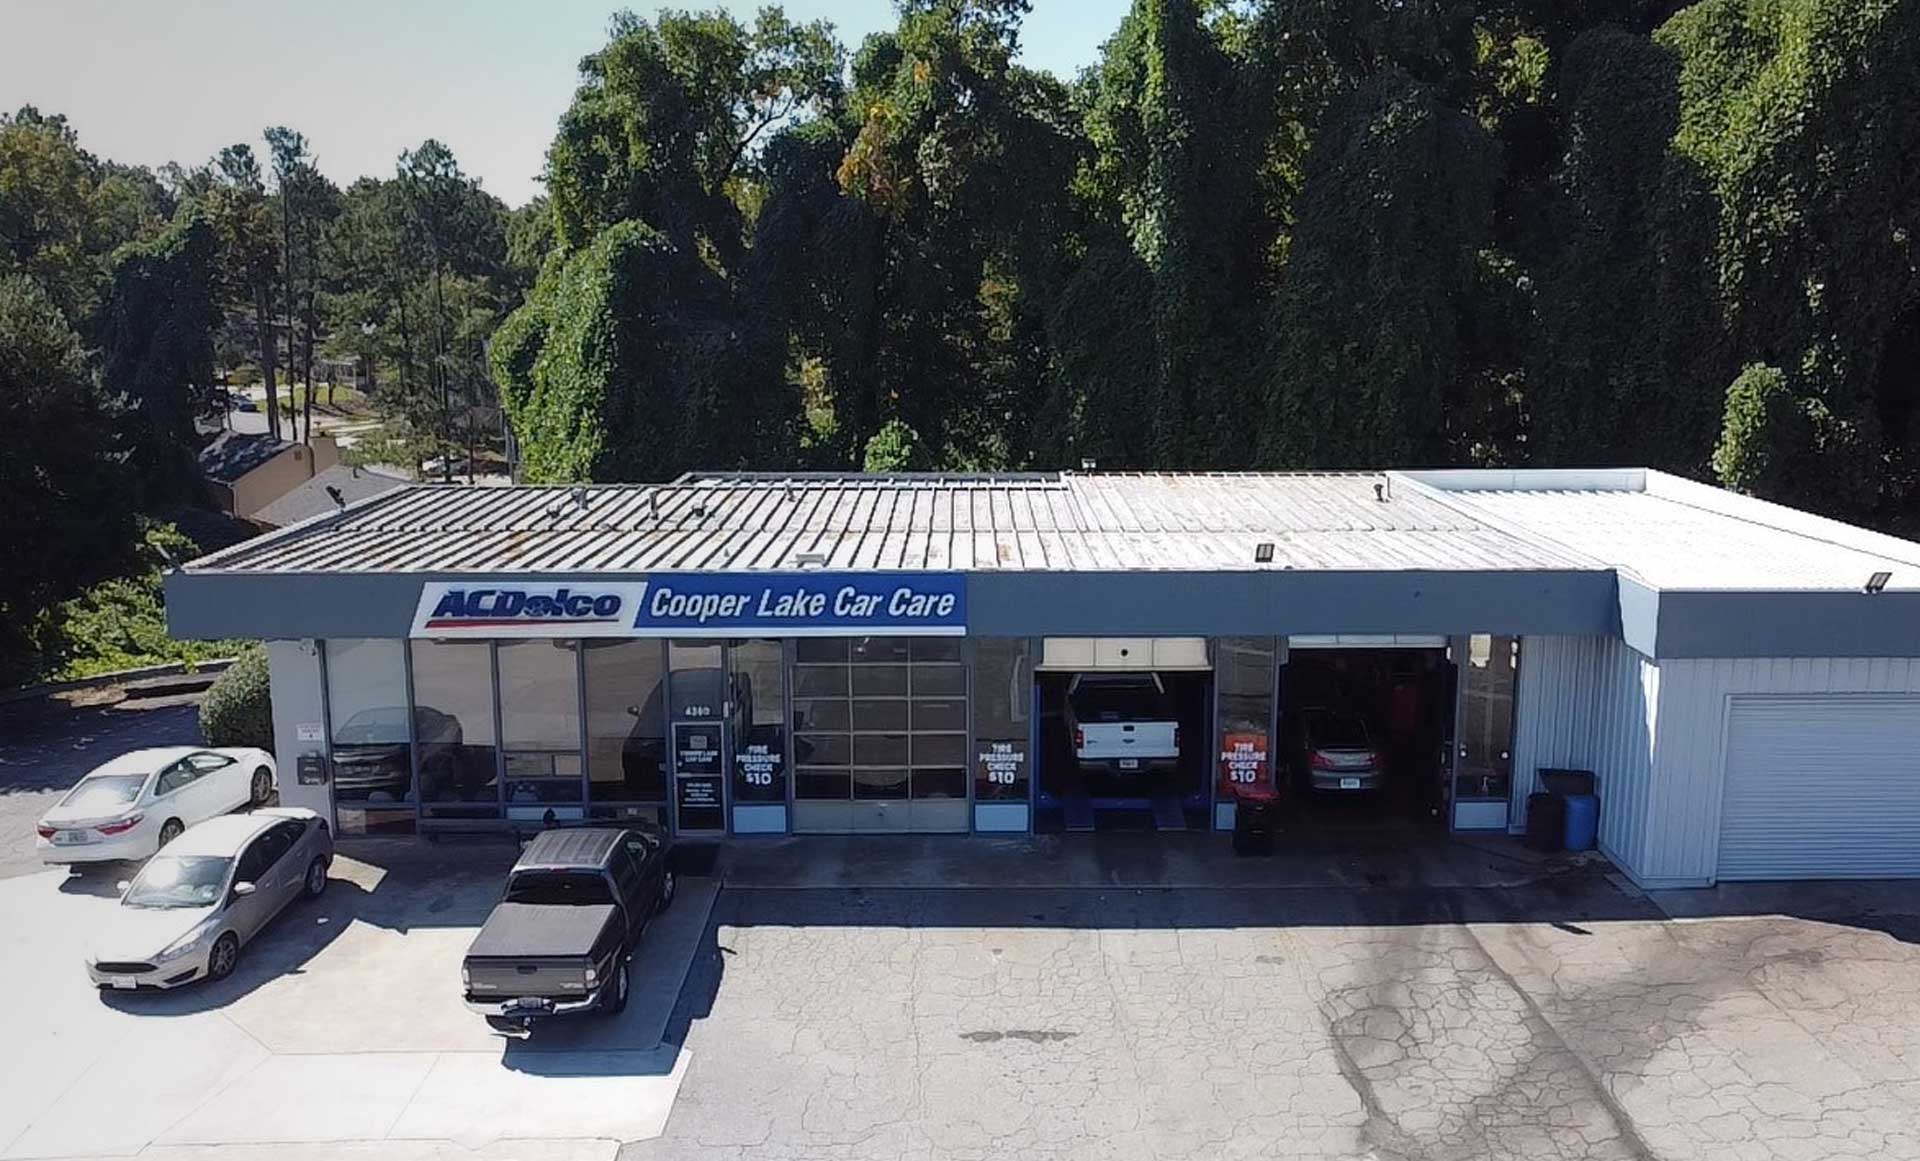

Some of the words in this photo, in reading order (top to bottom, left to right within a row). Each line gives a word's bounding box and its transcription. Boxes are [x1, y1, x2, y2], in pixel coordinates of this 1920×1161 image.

[431, 588, 622, 617] ACDelco
[651, 588, 751, 623] Cooper
[756, 588, 826, 617] Lake
[833, 586, 883, 617] Car
[888, 588, 956, 617] Care
[748, 745, 768, 754] TIRE
[992, 744, 1012, 753] TIRE
[1234, 743, 1254, 752] TIRE
[736, 754, 781, 763] PRESSURE
[979, 753, 1024, 762] PRESSURE
[1221, 752, 1266, 761] PRESSURE
[744, 763, 773, 772] CHECK
[987, 762, 1017, 771] CHECK
[1228, 761, 1258, 770] CHECK
[746, 773, 772, 785] $10
[988, 771, 1015, 784] $10
[1230, 770, 1256, 783] $10
